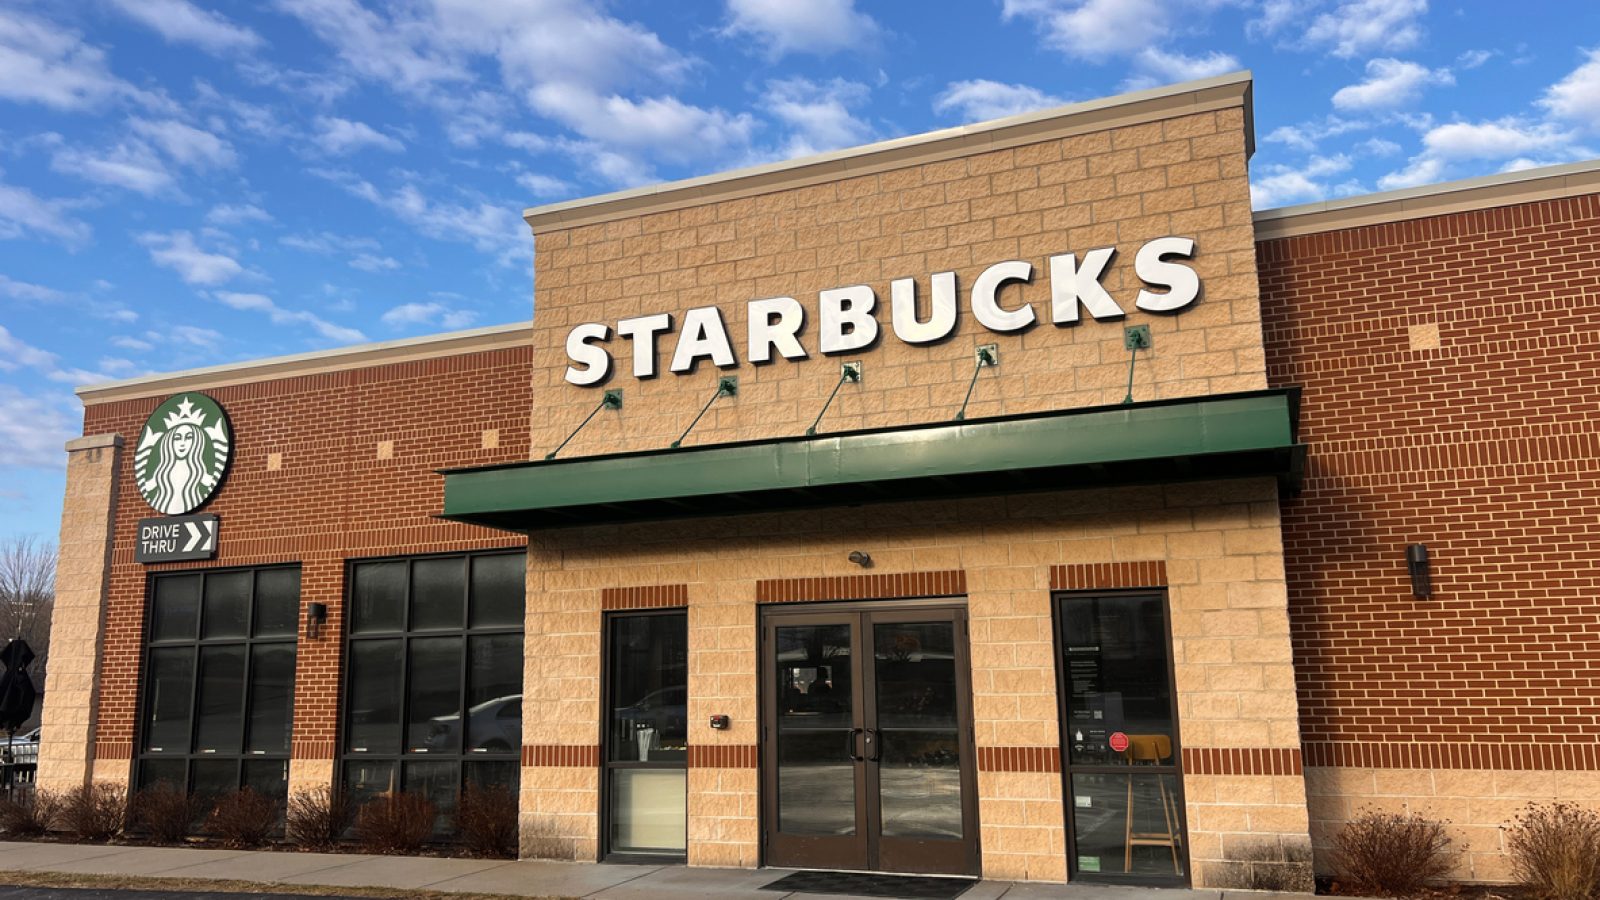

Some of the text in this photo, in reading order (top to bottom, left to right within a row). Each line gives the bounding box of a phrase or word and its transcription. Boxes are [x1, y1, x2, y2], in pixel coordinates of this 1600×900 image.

[565, 237, 1202, 386] STARBUCKS
[142, 524, 180, 540] DRIVE
[141, 539, 177, 554] THRU
